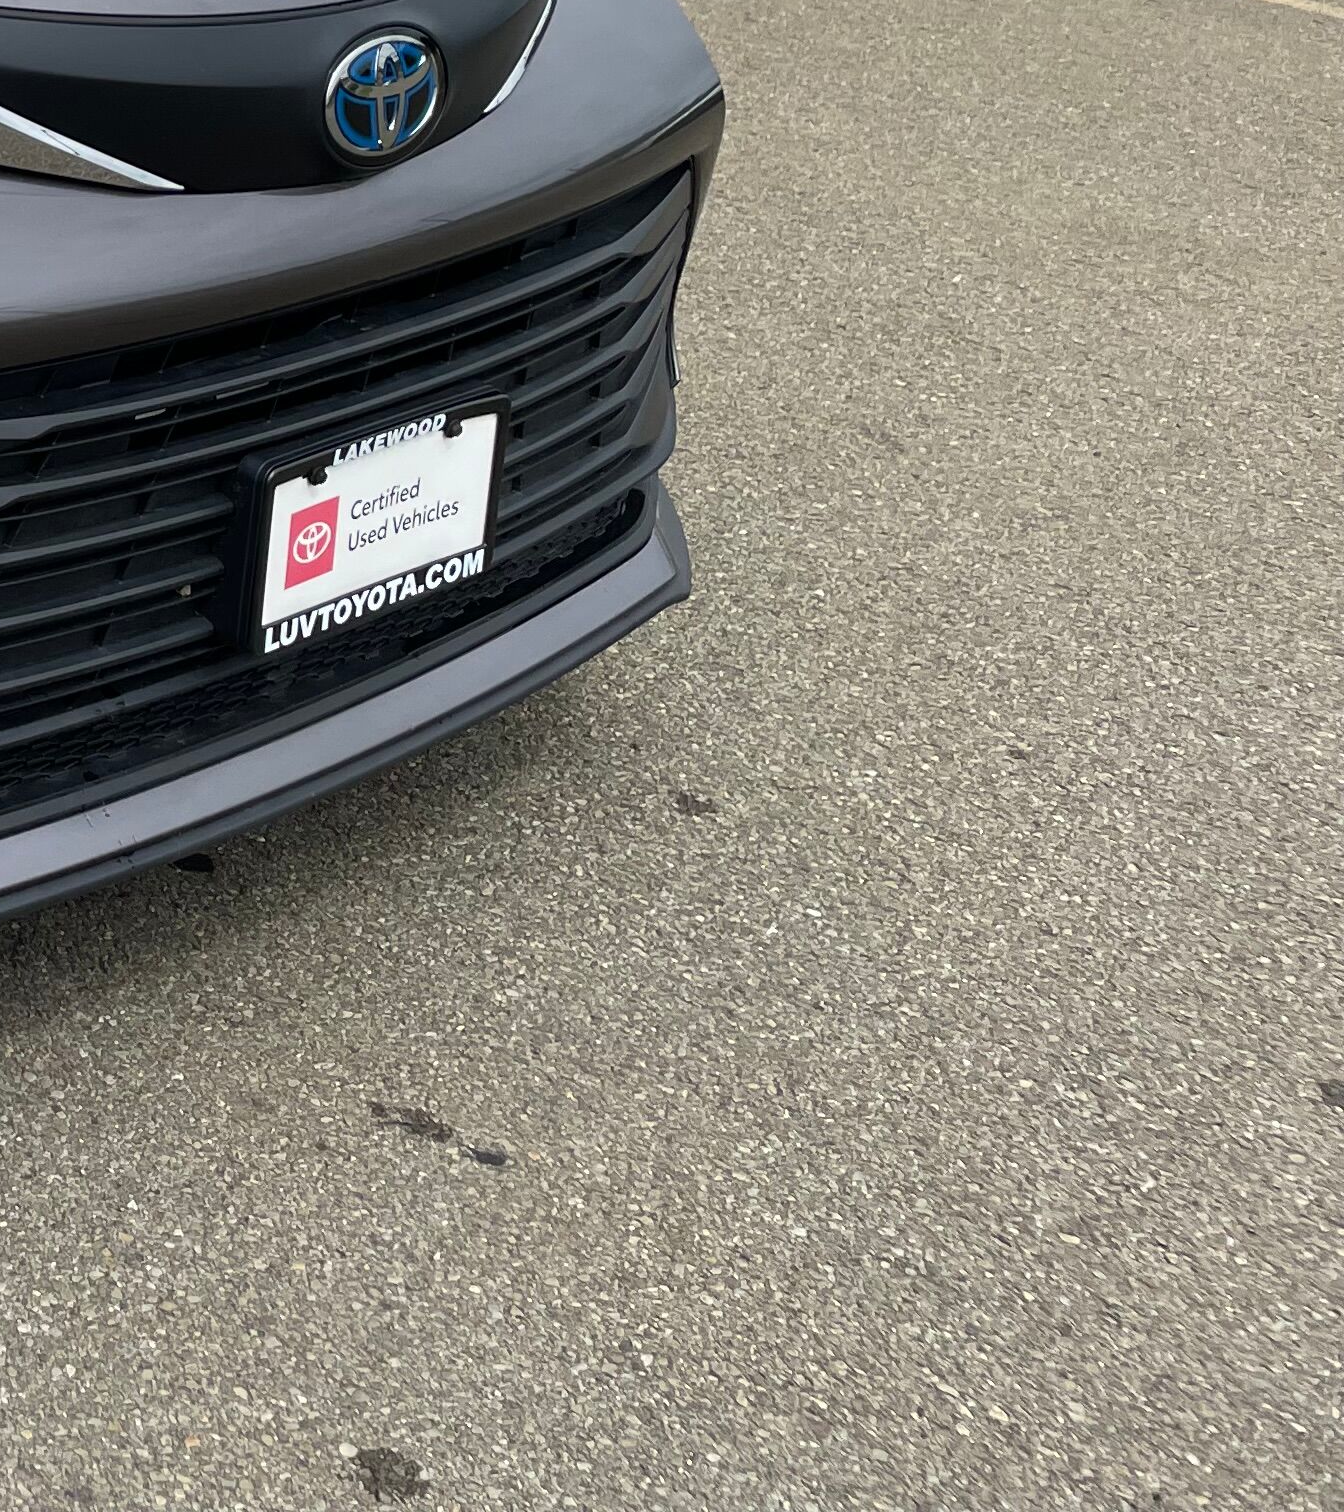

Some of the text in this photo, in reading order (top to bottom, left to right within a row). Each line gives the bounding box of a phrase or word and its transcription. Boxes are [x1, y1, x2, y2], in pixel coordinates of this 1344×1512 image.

[332, 413, 447, 467] LAKEWOOD
[348, 498, 460, 552] Used Vehicles
[351, 477, 421, 520] Certified
[263, 548, 486, 654] LUVTOYOTA.COM
